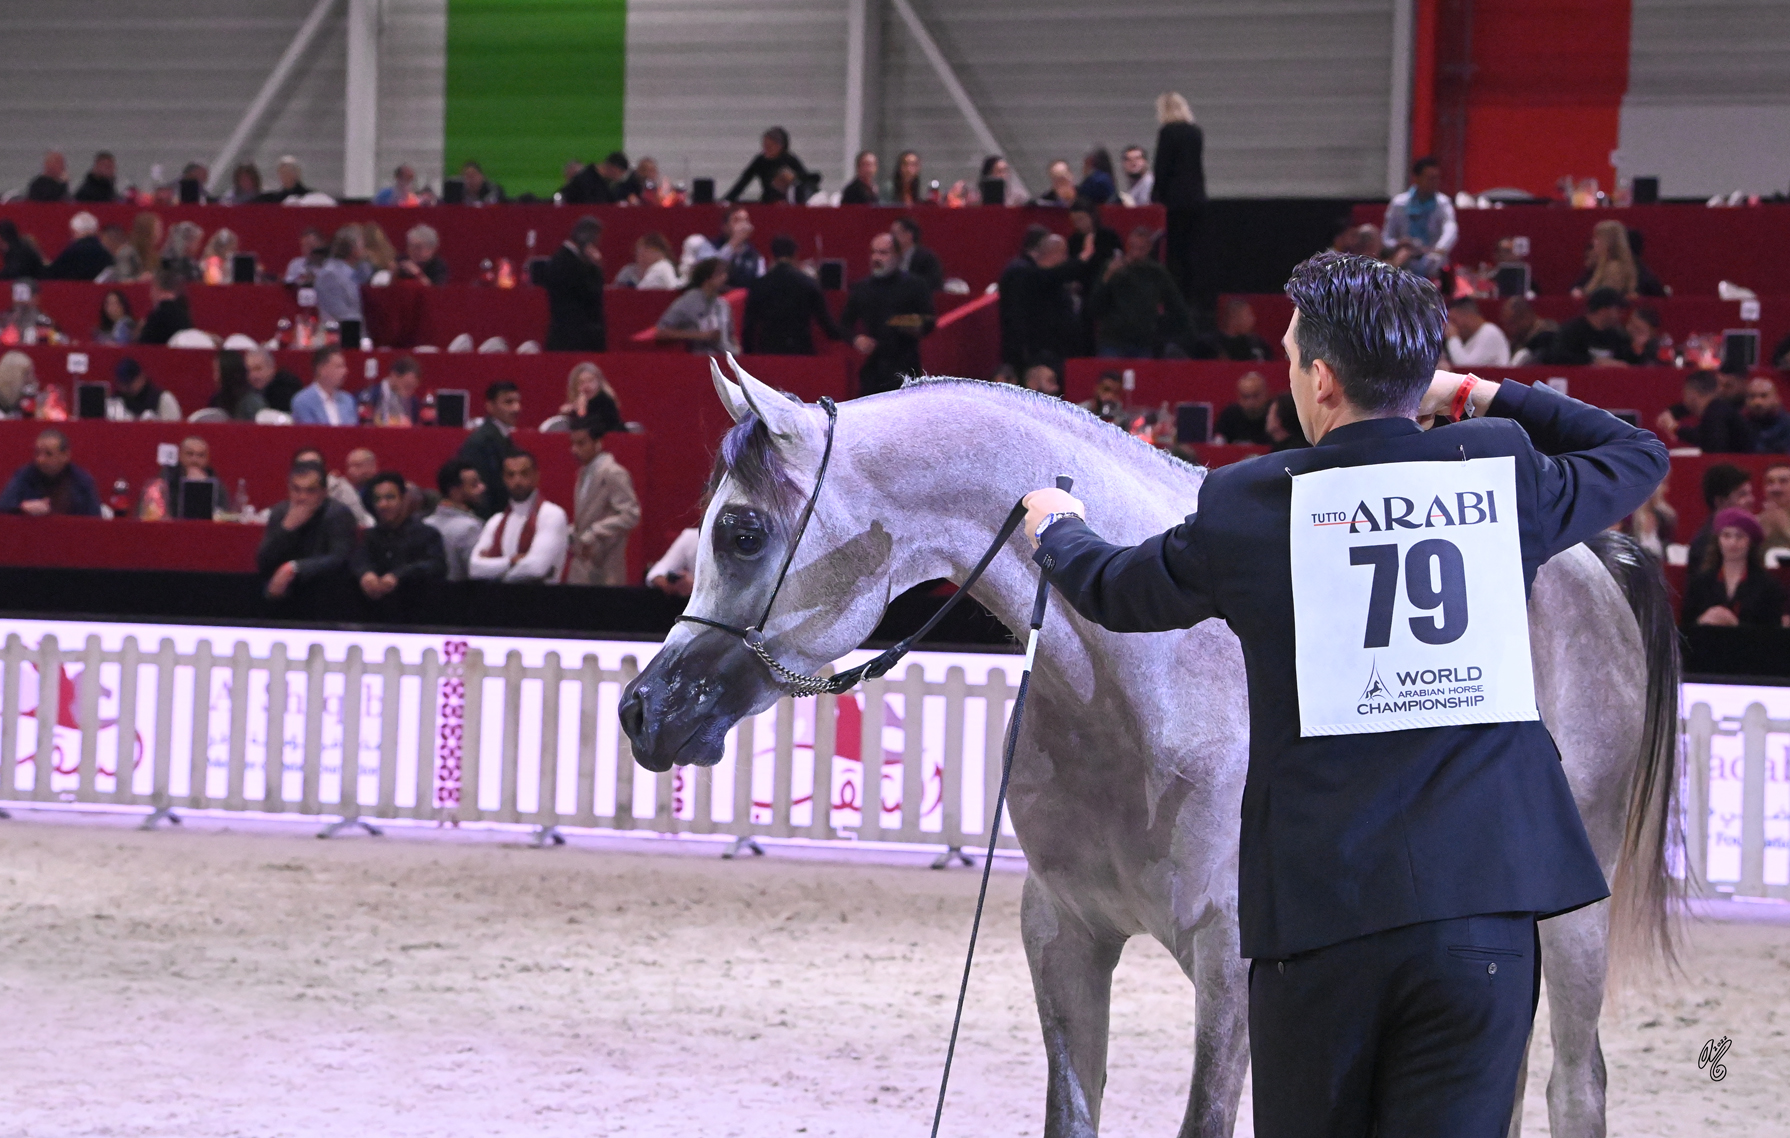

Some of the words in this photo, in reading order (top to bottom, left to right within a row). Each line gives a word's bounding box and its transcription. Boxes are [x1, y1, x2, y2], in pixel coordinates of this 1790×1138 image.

[1311, 512, 1346, 523] TUTTO
[1349, 490, 1498, 533] ARABI
[1349, 538, 1468, 648] 79
[1396, 666, 1482, 686] WORLD
[1398, 688, 1445, 698] ARABIAN
[1448, 685, 1484, 693] HORSE
[1357, 695, 1485, 715] CHAMPIONSHIP
